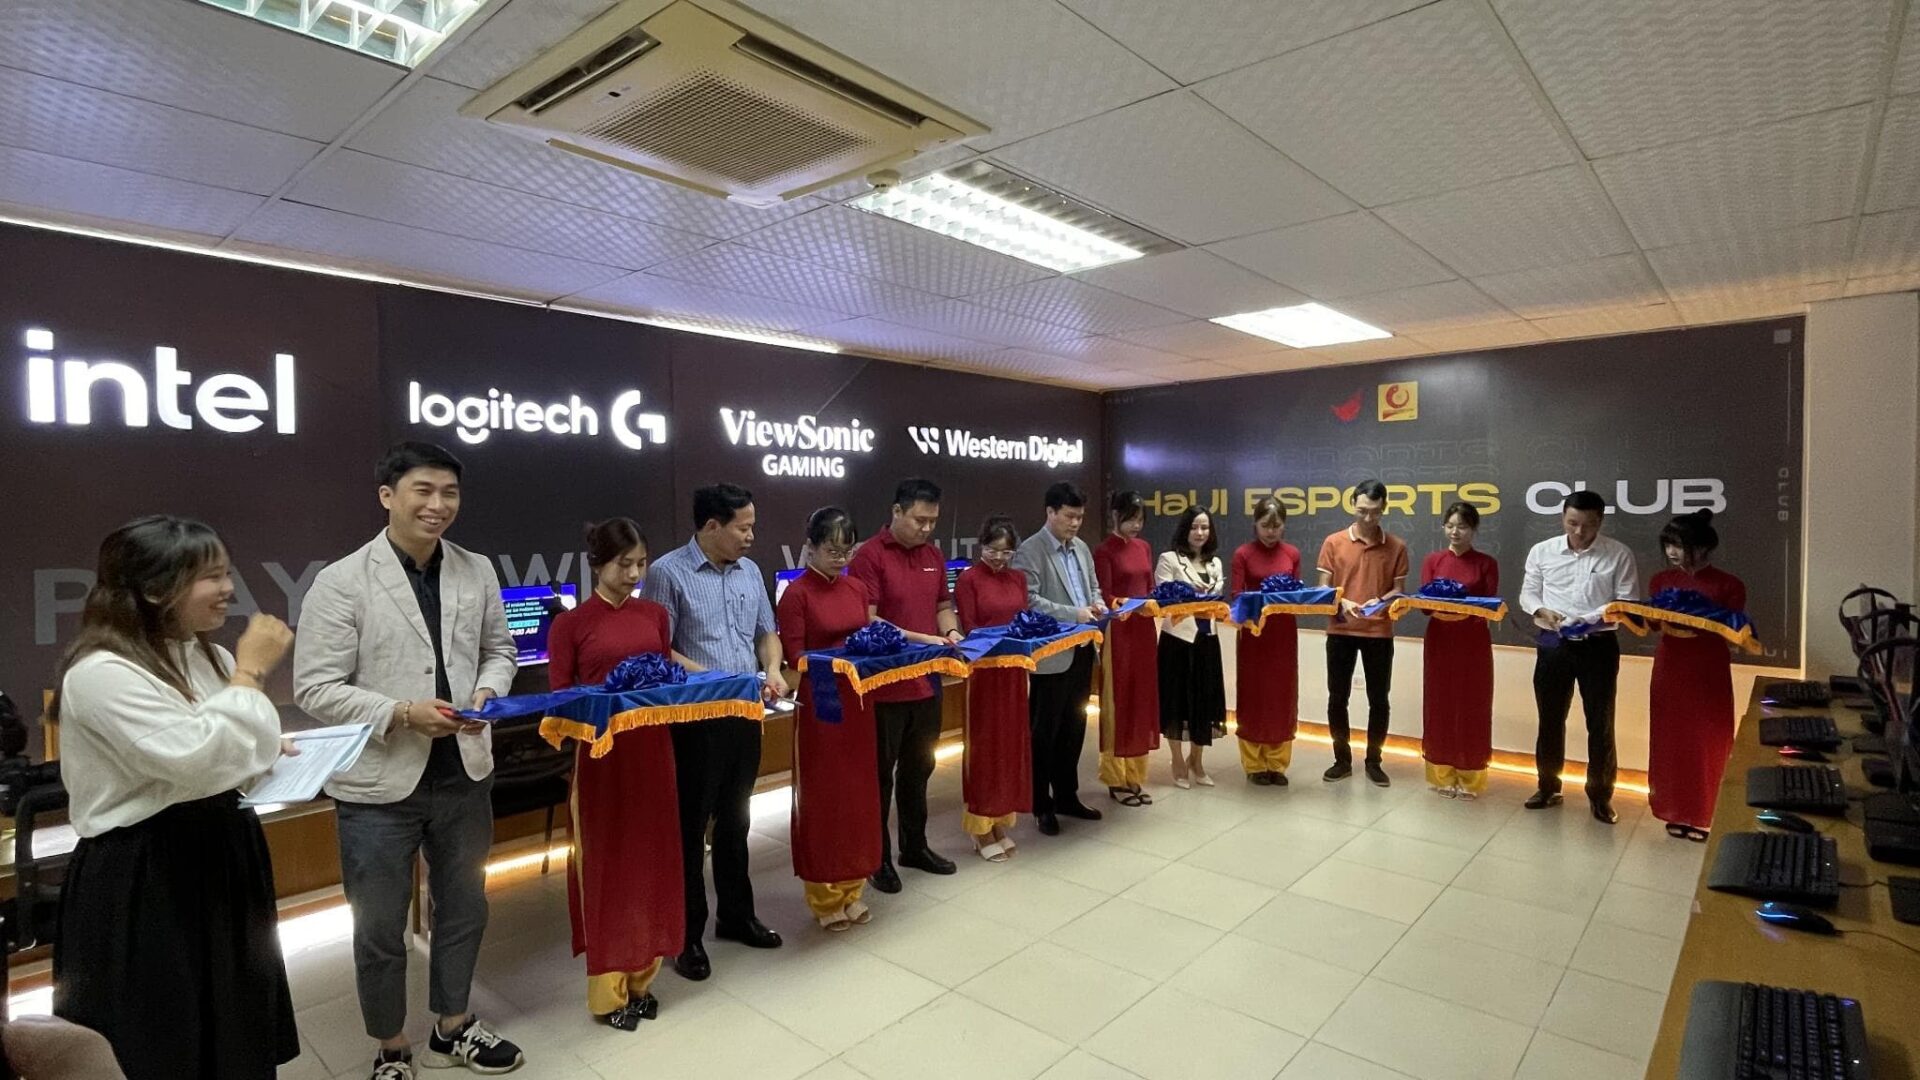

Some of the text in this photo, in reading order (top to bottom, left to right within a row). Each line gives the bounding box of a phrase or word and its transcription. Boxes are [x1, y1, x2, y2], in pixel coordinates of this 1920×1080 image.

[24, 327, 297, 434] intel
[409, 380, 599, 445] logitech
[719, 407, 876, 452] ViewSonic
[762, 454, 846, 478] GAMING
[944, 428, 1084, 469] Western Digital
[33, 560, 328, 646] PAY
